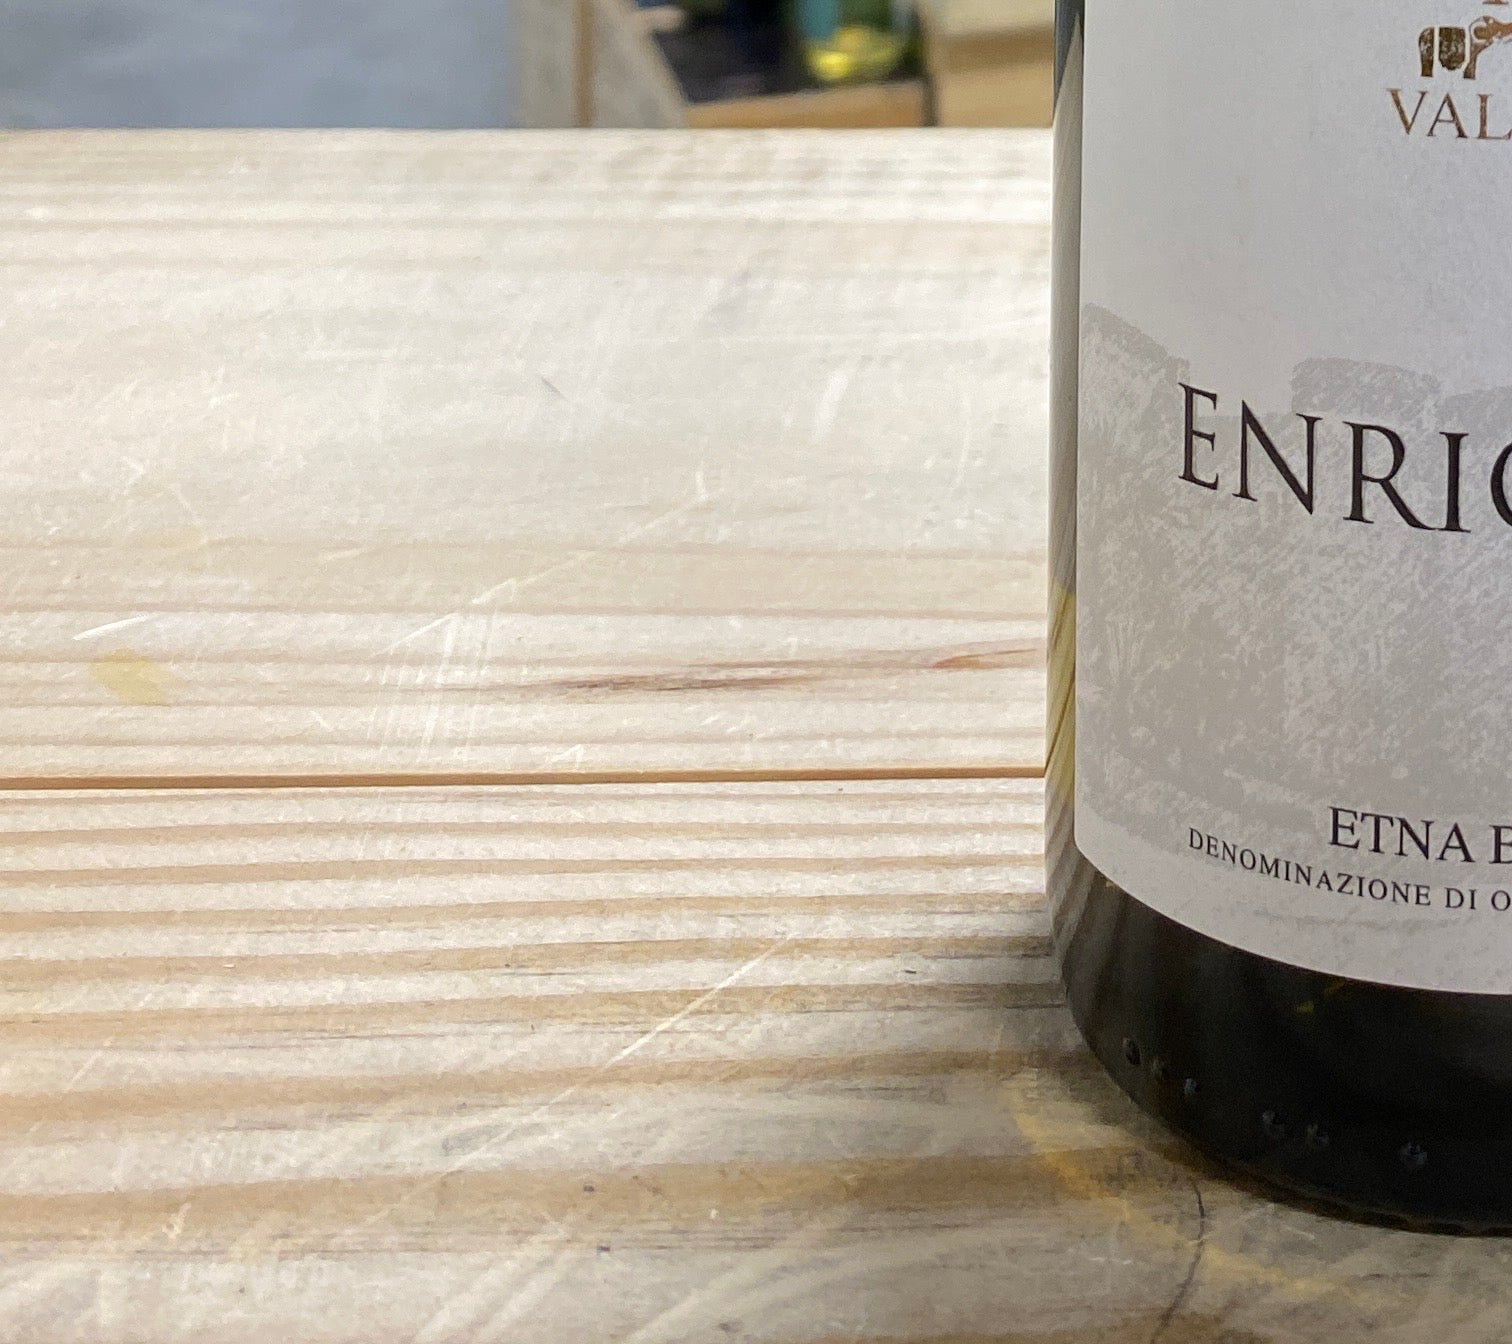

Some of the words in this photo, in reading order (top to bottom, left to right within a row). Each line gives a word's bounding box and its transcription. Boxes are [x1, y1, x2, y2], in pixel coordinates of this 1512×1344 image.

[1187, 826, 1432, 909] DENOMINAZIONE
[1443, 887, 1478, 912] DI
[1328, 805, 1476, 865] ETNA
